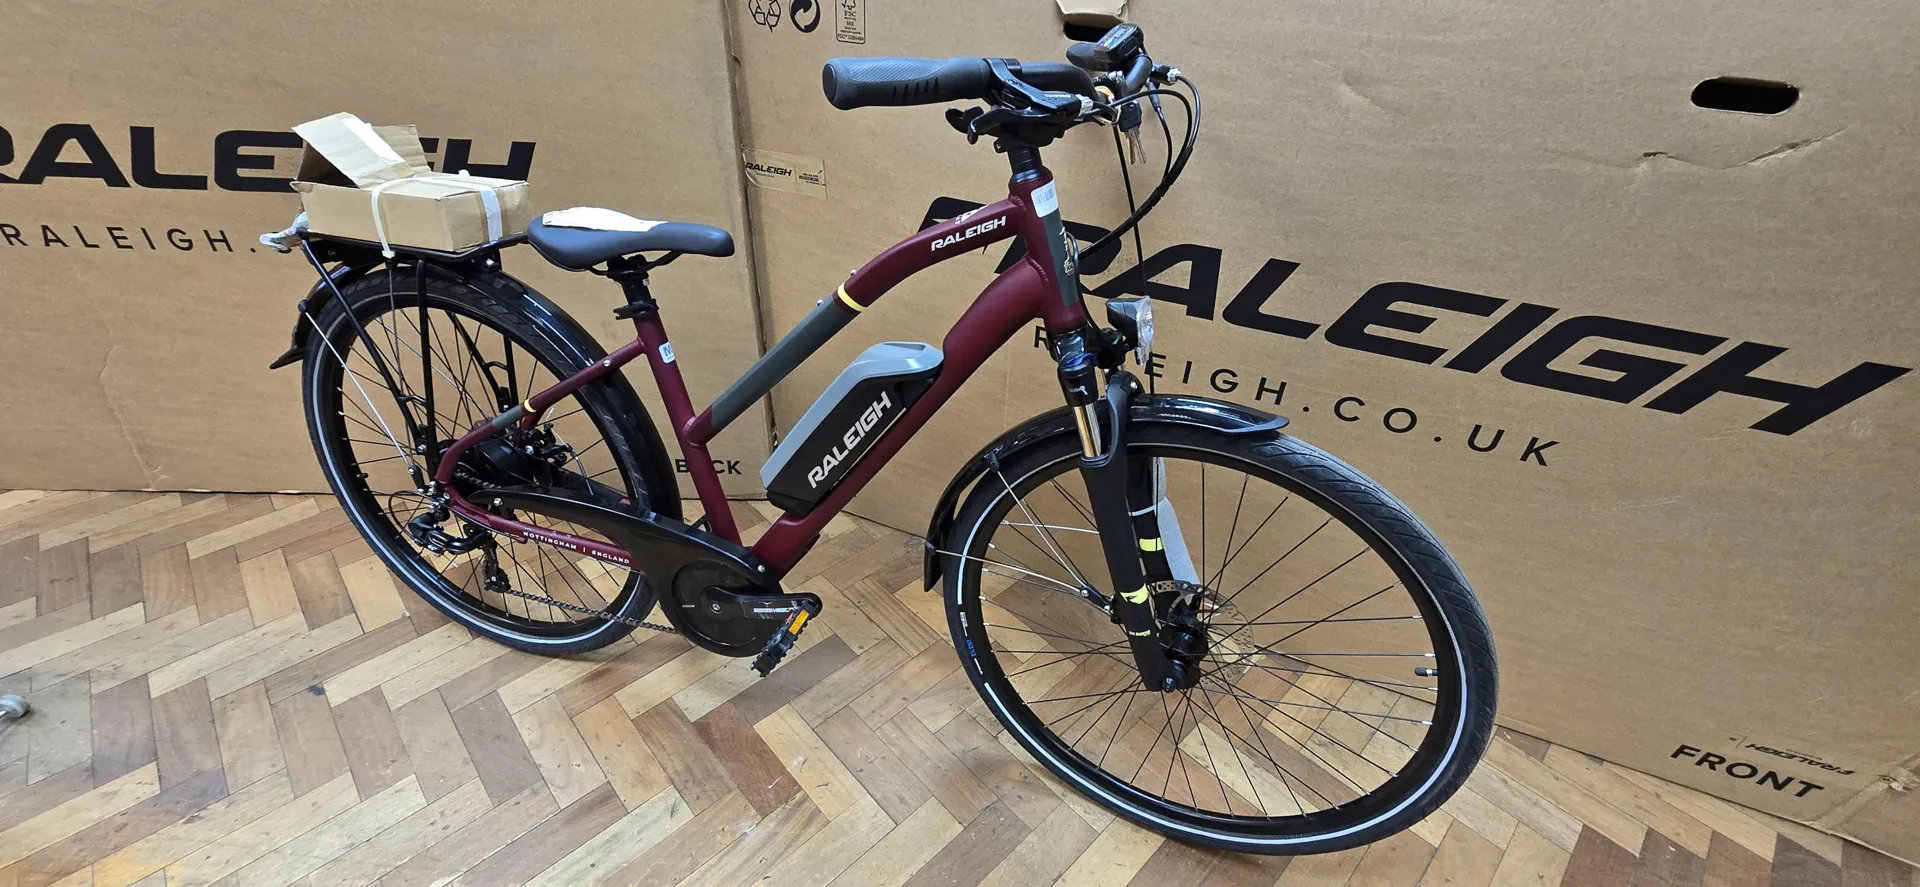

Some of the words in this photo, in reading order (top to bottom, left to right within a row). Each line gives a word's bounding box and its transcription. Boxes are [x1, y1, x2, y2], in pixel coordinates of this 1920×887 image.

[0, 123, 537, 193] ALEH
[745, 162, 792, 177] RALEIGH
[931, 215, 1007, 252] RALEIGH
[1033, 325, 1561, 467] REIGH.CO.UK
[807, 390, 892, 489] RALEIGH
[675, 458, 743, 475] BCK
[523, 531, 577, 550] NOTTINGHAM
[591, 550, 630, 564] ENGLAND
[1670, 744, 1825, 798] FRONT
